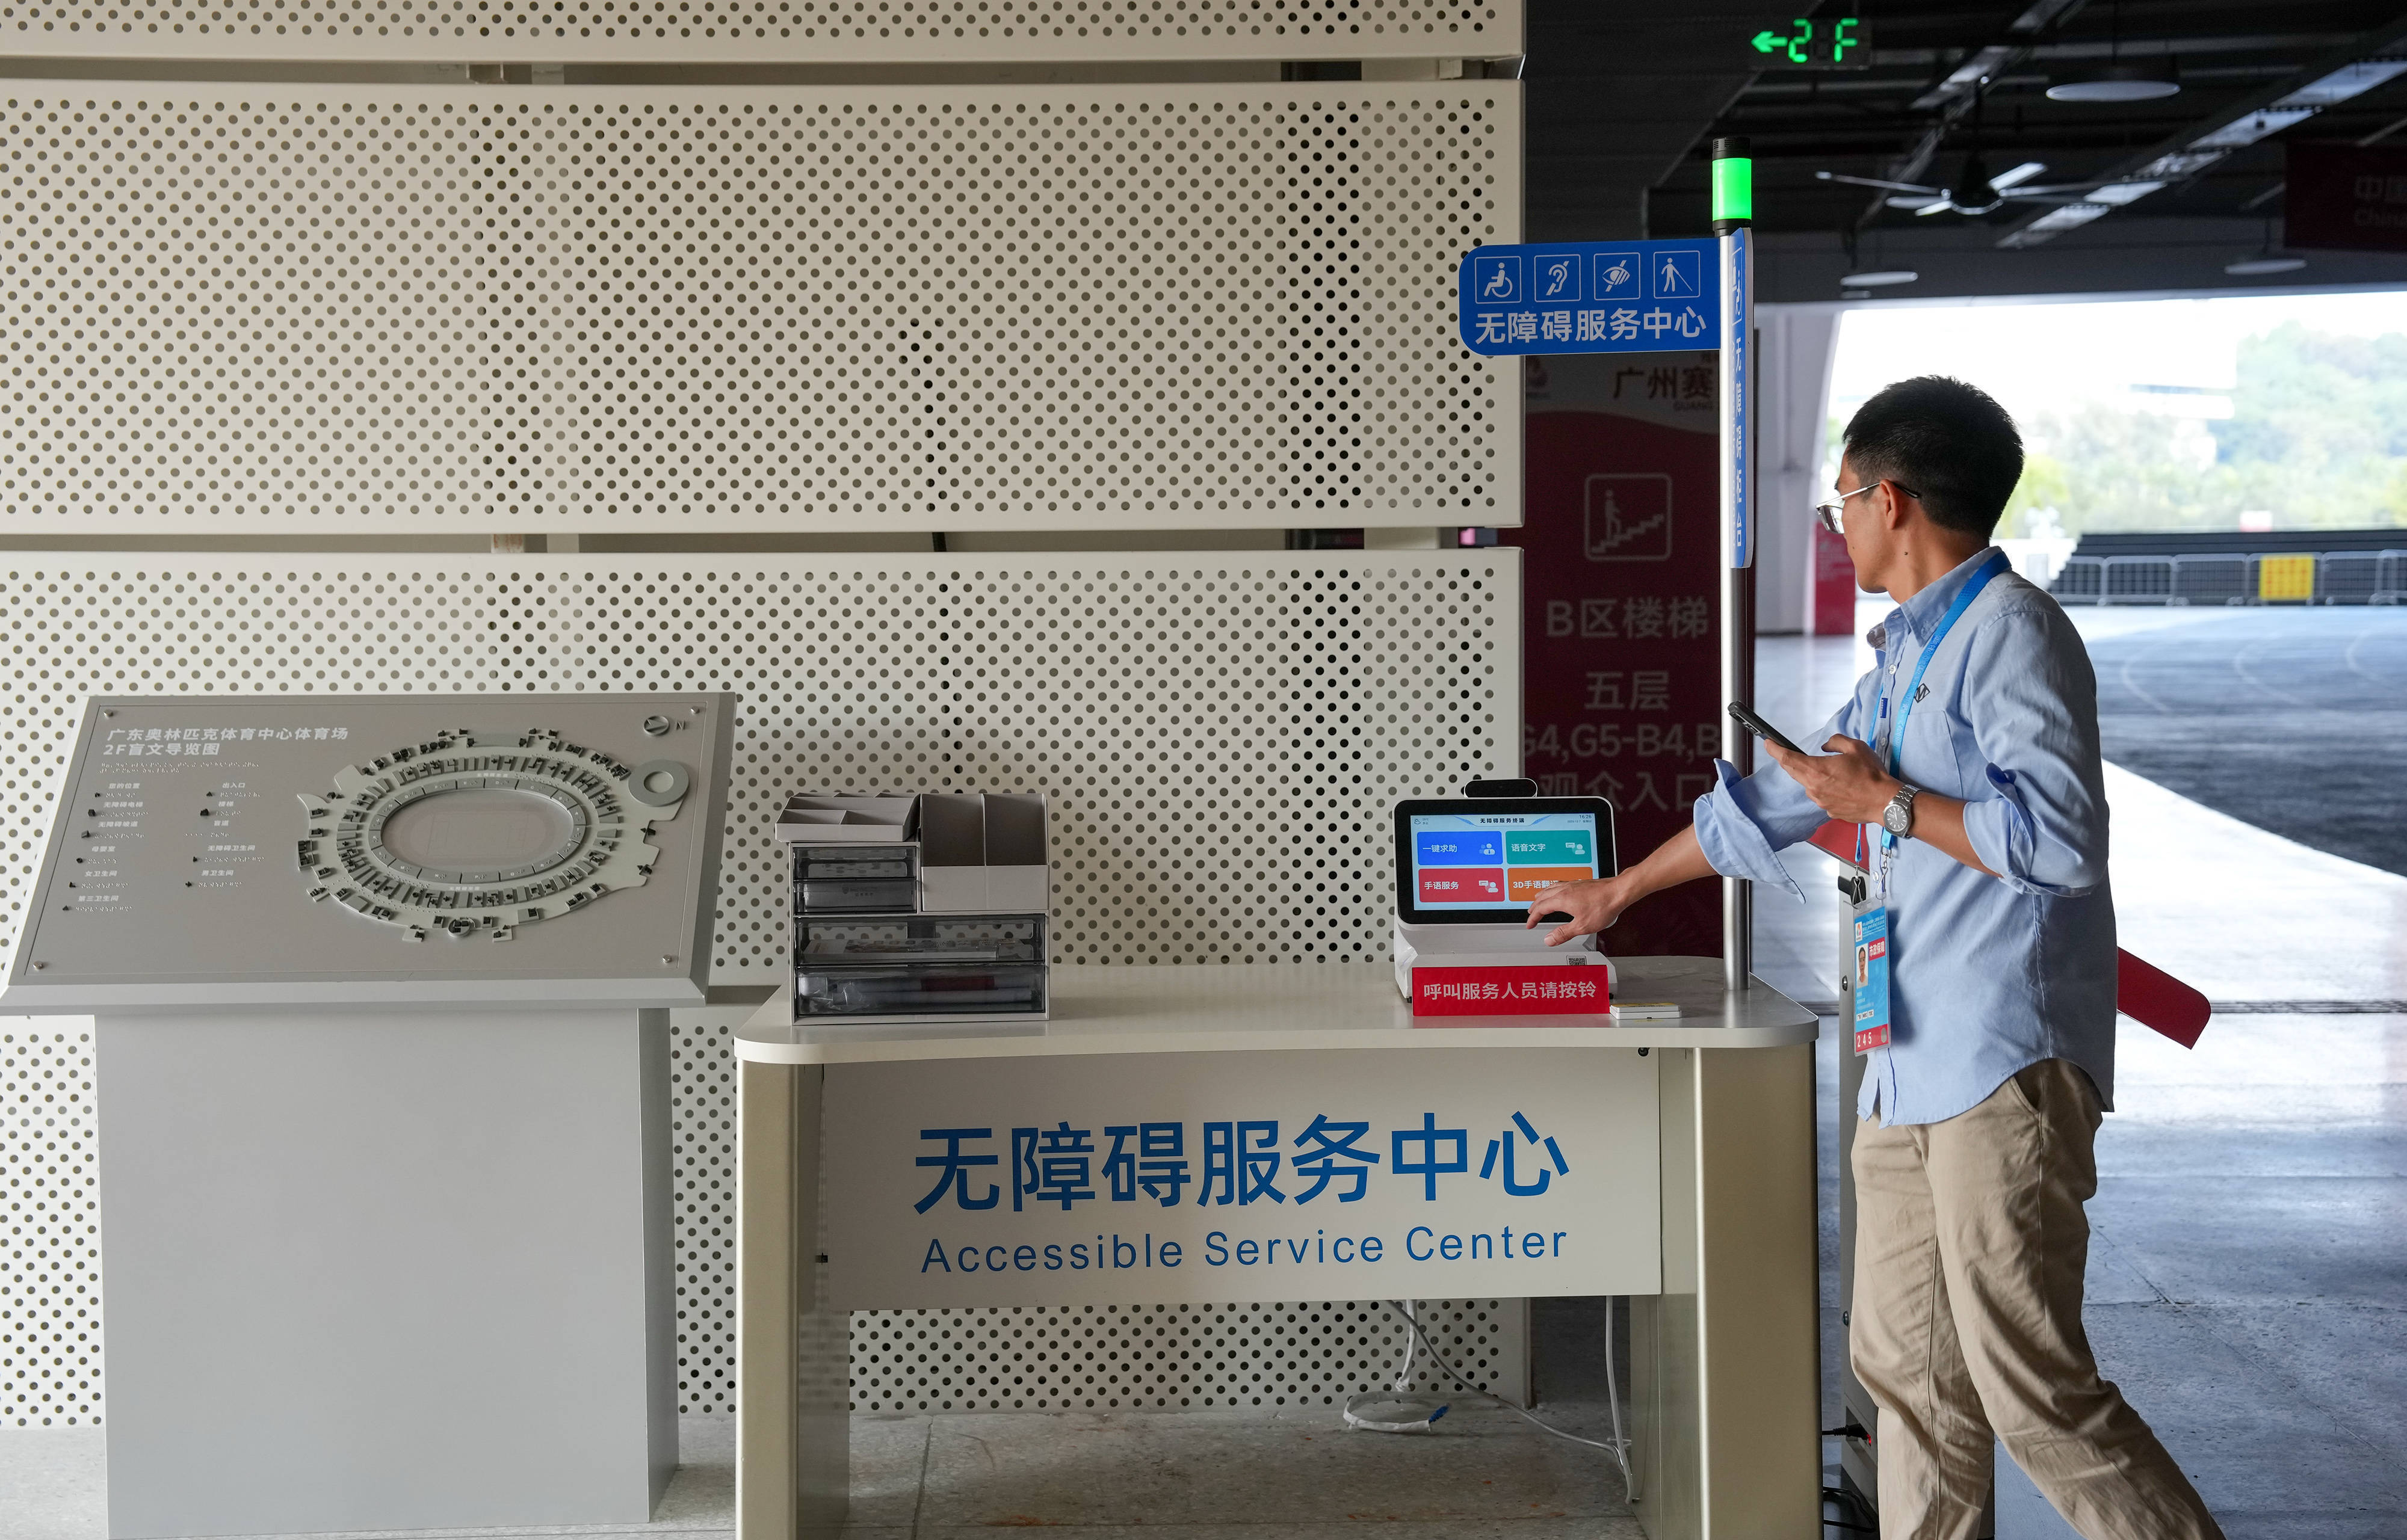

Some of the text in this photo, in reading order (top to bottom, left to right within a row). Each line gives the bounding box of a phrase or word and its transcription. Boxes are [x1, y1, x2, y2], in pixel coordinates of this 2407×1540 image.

[1475, 306, 1707, 345] 无障碍服务中心
[1613, 365, 1713, 399] 广州赛
[1546, 596, 1708, 639] B区楼梯
[1584, 671, 1670, 711] 五层
[107, 727, 348, 741] 广东奥林匹克体育中心体育场
[103, 743, 220, 756] 2F盲文导览图
[1423, 843, 1457, 852] 一键求助
[1511, 843, 1546, 852] 语音文字
[1424, 881, 1459, 890] 手语服务
[1423, 981, 1596, 1000] 呼叫服务人员请按铃
[913, 1111, 1570, 1216] 无障碍服务中心
[921, 1225, 1567, 1274] Accessible Service Center
